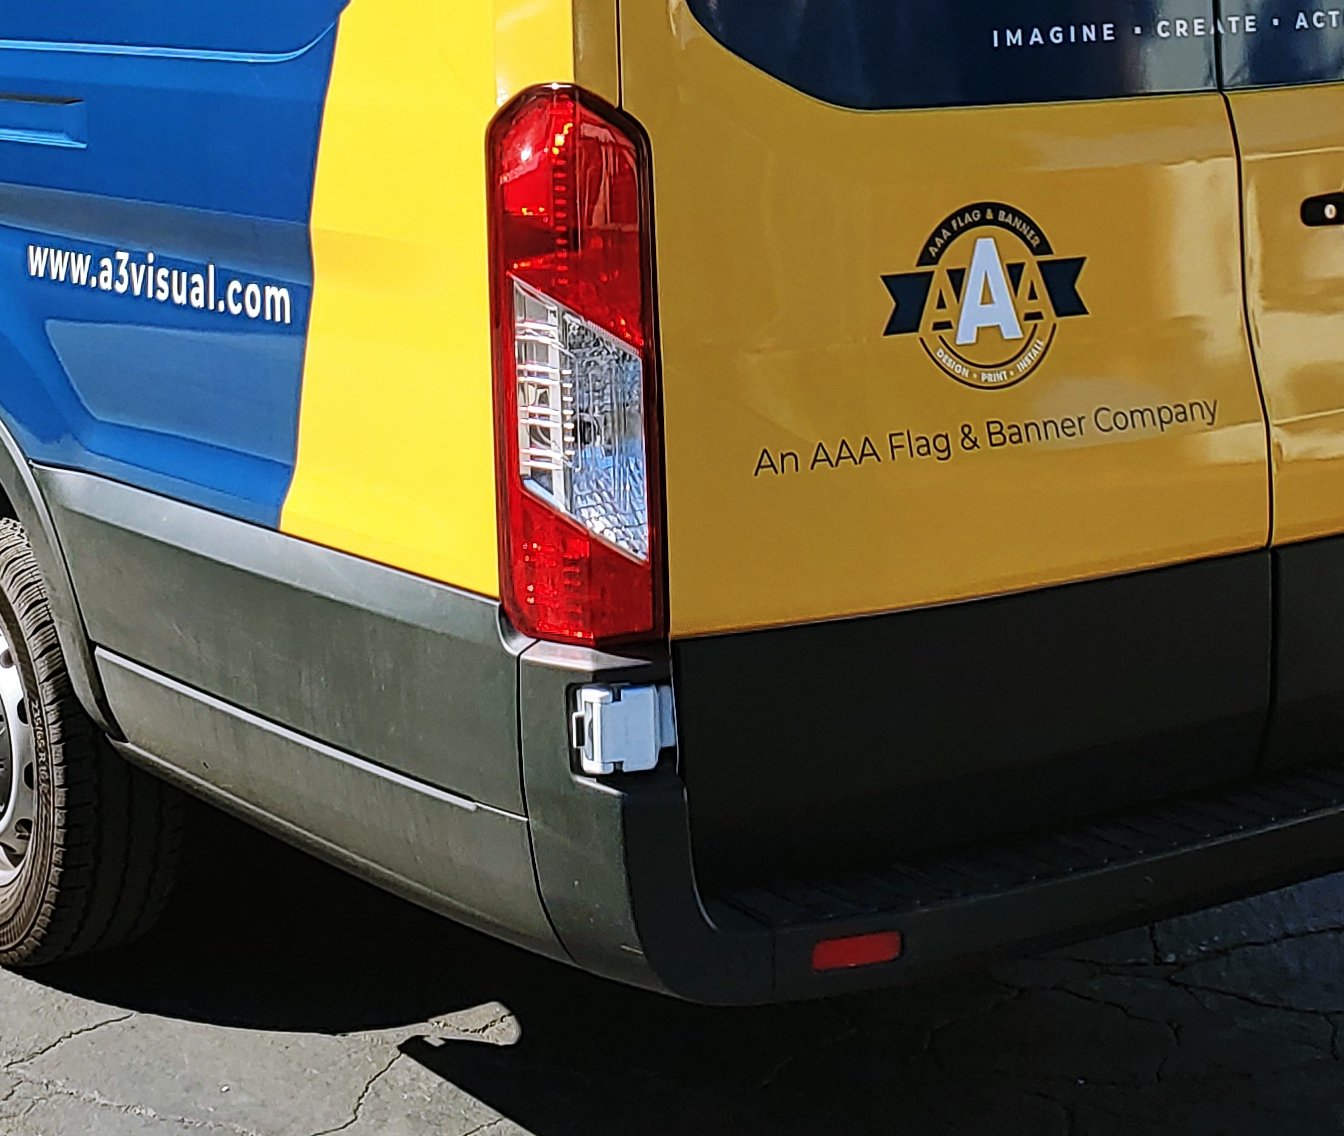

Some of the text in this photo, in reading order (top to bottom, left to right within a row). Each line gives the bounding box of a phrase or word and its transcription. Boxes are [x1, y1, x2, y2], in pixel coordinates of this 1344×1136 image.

[992, 22, 1116, 48] IMAGINE
[1156, 15, 1257, 39] CREATE
[928, 229, 952, 258] AAA
[951, 209, 982, 231] FLAG
[998, 210, 1041, 248] BANNER
[27, 244, 292, 325] www.a3visual.com
[936, 347, 970, 379] DESIGN
[980, 370, 1009, 383] PRINT
[754, 398, 1218, 477] An AAA Flag & Banner Company
